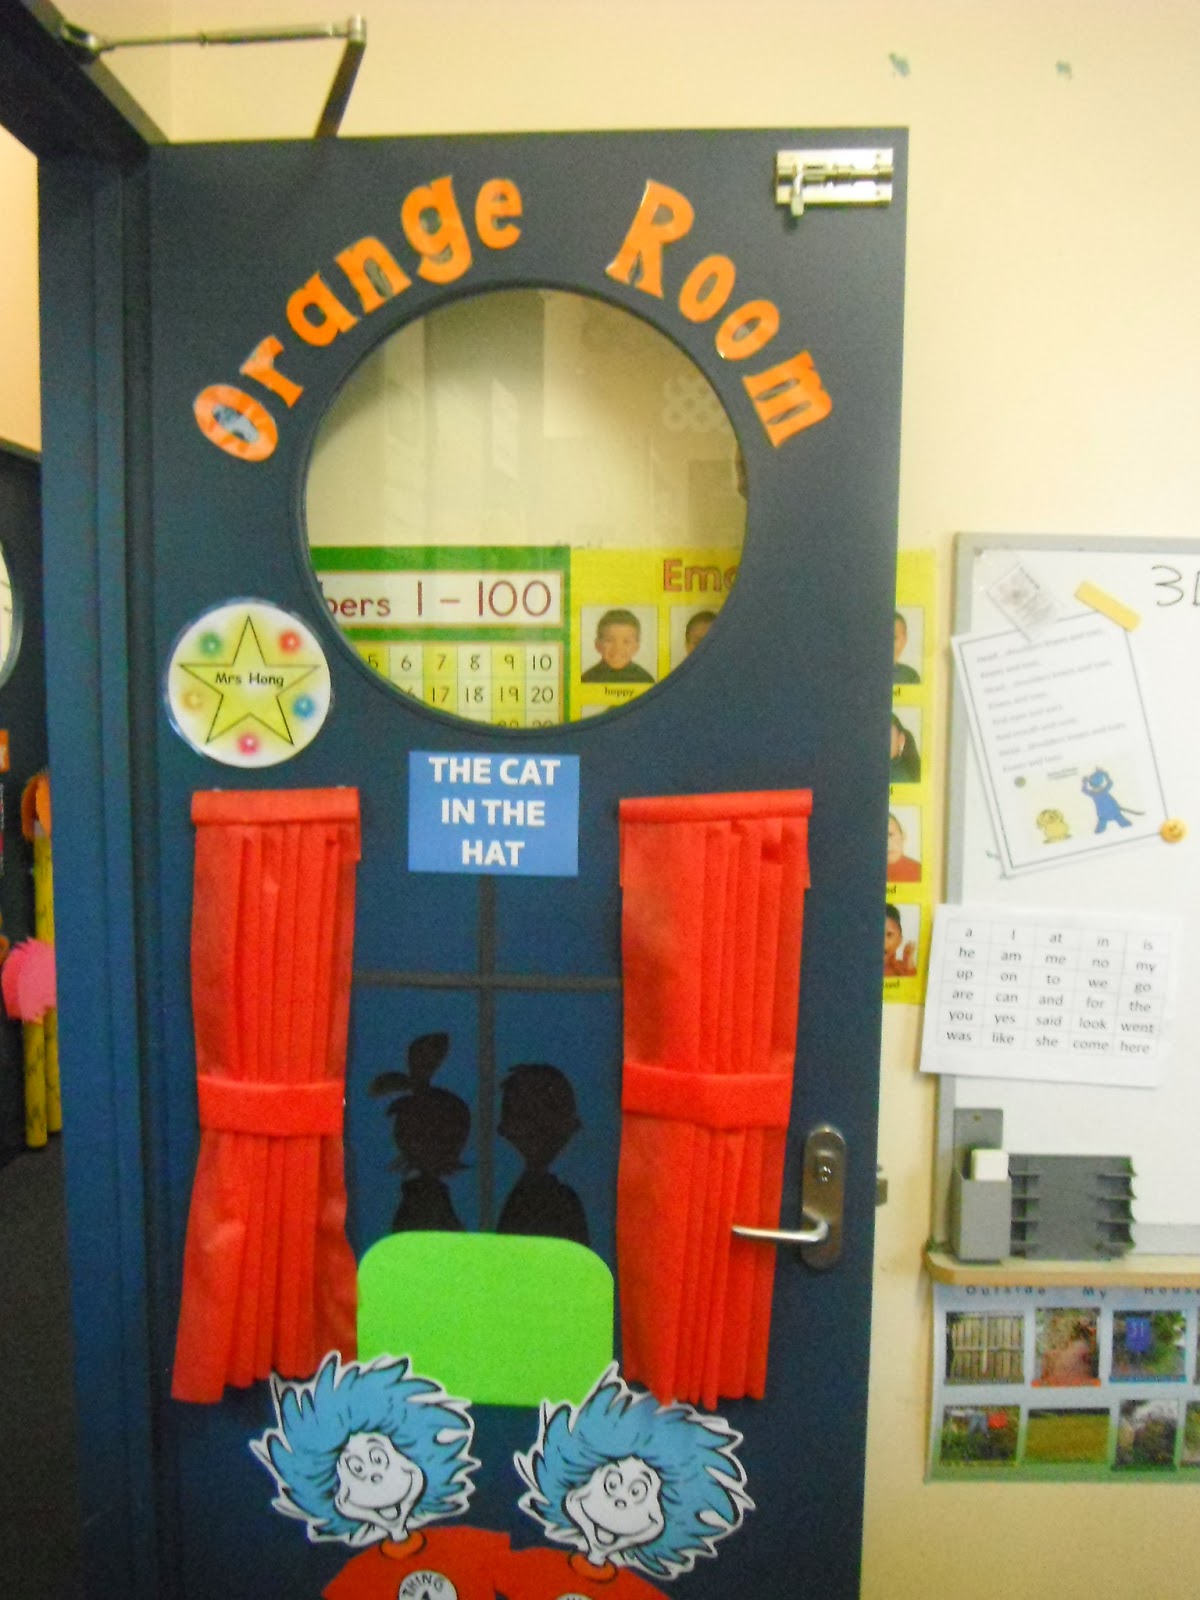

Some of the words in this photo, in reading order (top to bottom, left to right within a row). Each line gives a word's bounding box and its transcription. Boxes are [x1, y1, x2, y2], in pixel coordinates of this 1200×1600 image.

[194, 175, 522, 462] Orange
[605, 179, 833, 448] Room
[478, 580, 552, 617] 100
[401, 654, 412, 671] 6
[437, 653, 447, 670] 7
[470, 654, 481, 671] 8
[504, 654, 515, 670] 9
[532, 654, 552, 671] 10
[215, 672, 242, 684] Mrs
[432, 687, 450, 702] 17
[466, 686, 484, 702] 18
[500, 686, 519, 702] 19
[531, 686, 554, 703] 20
[428, 756, 492, 784] THE
[500, 758, 561, 786] CAT
[441, 797, 475, 825] IN
[482, 799, 546, 827] THE
[462, 839, 526, 867] HAT
[1049, 932, 1062, 944] at
[1097, 936, 1110, 947] in
[1143, 939, 1154, 951] is
[958, 947, 976, 959] he
[1000, 952, 1022, 962] am
[1045, 954, 1066, 965] me
[1092, 958, 1110, 969] no
[1136, 962, 1157, 975] my
[956, 969, 973, 980] up
[1000, 973, 1018, 982] on
[1046, 975, 1061, 985] to
[1088, 978, 1108, 989] we
[1134, 982, 1152, 995] go
[952, 990, 974, 1000] are
[995, 993, 1018, 1003] can
[1038, 995, 1064, 1006] and
[1086, 997, 1105, 1009] for
[1129, 1000, 1151, 1013] the
[949, 1011, 973, 1022] you
[994, 1013, 1016, 1025] yes
[1035, 1015, 1062, 1027] said
[1079, 1017, 1107, 1030] look
[1120, 1022, 1154, 1034] went
[946, 1031, 972, 1042] was
[992, 1032, 1014, 1045] like
[1035, 1036, 1058, 1048] she
[1073, 1039, 1109, 1050] come
[1120, 1041, 1150, 1055] here
[402, 1574, 443, 1598] THING
